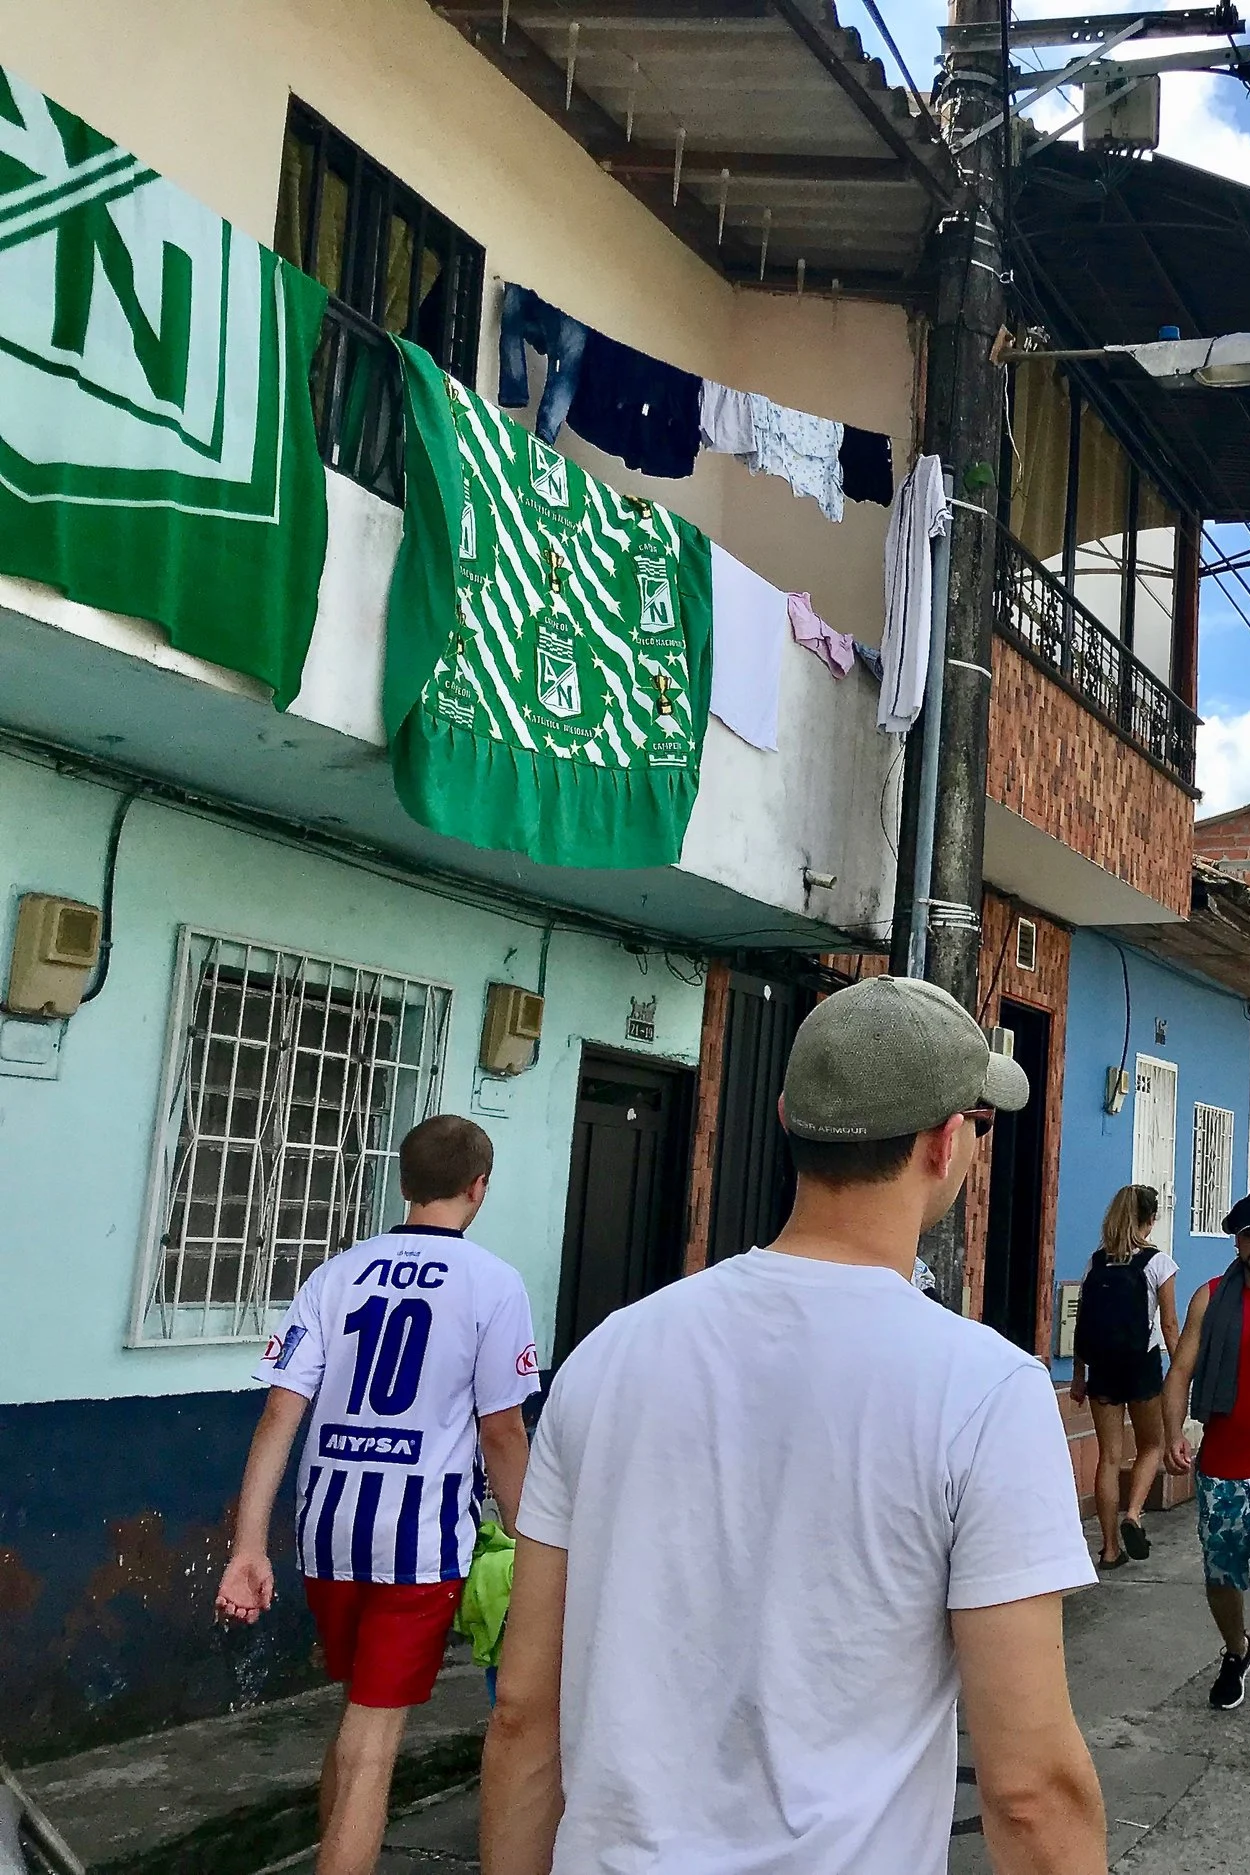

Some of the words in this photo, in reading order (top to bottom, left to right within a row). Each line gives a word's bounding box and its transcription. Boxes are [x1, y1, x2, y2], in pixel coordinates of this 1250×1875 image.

[51, 198, 193, 415] N
[650, 600, 669, 624] N
[544, 655, 558, 684] A
[557, 684, 574, 709] N
[818, 1126, 867, 1135] ARMOUR
[343, 1296, 433, 1416] 10
